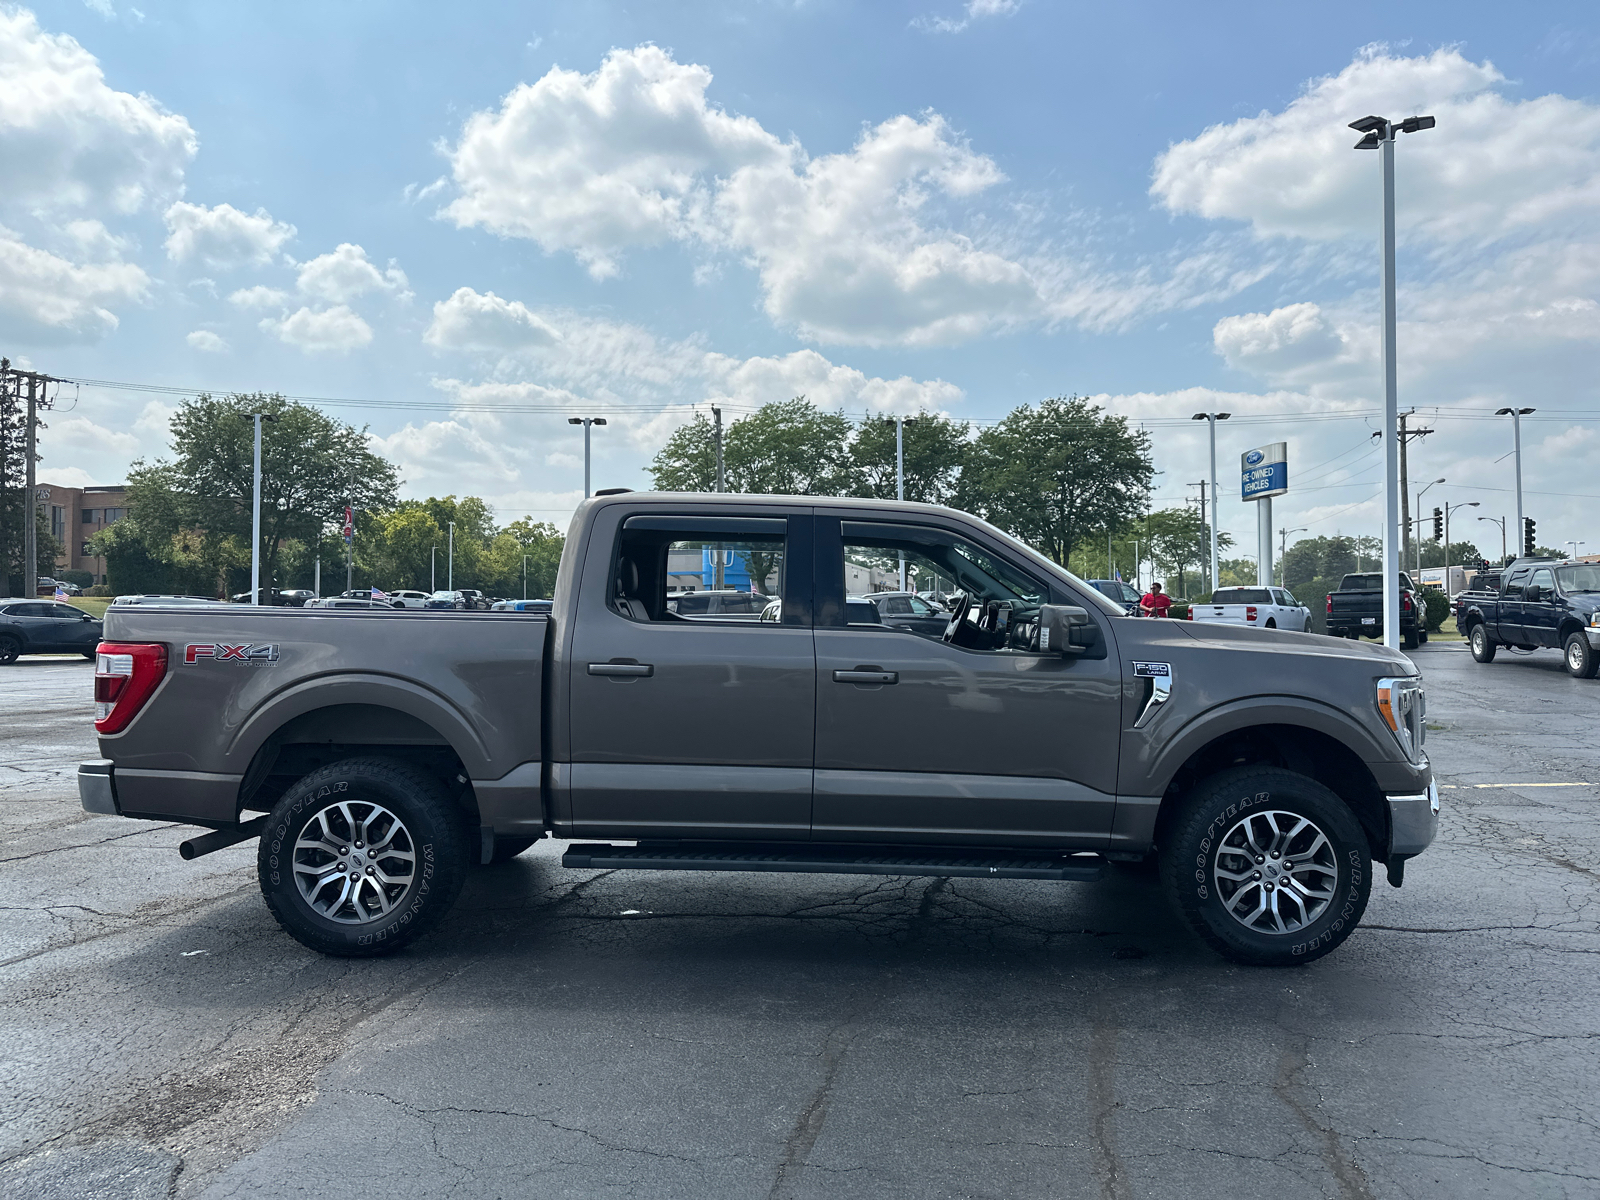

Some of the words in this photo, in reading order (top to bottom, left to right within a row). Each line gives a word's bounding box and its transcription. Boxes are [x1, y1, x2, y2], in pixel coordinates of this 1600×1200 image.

[1242, 467, 1274, 482] PRE-OWNED
[1244, 479, 1269, 492] VEHICLES
[183, 642, 280, 665] FX4
[270, 781, 348, 885] GOODYEAR
[1196, 792, 1270, 899] GOODYEAR
[358, 843, 435, 945] WRANGLER
[1291, 850, 1361, 955] WRANGLER
